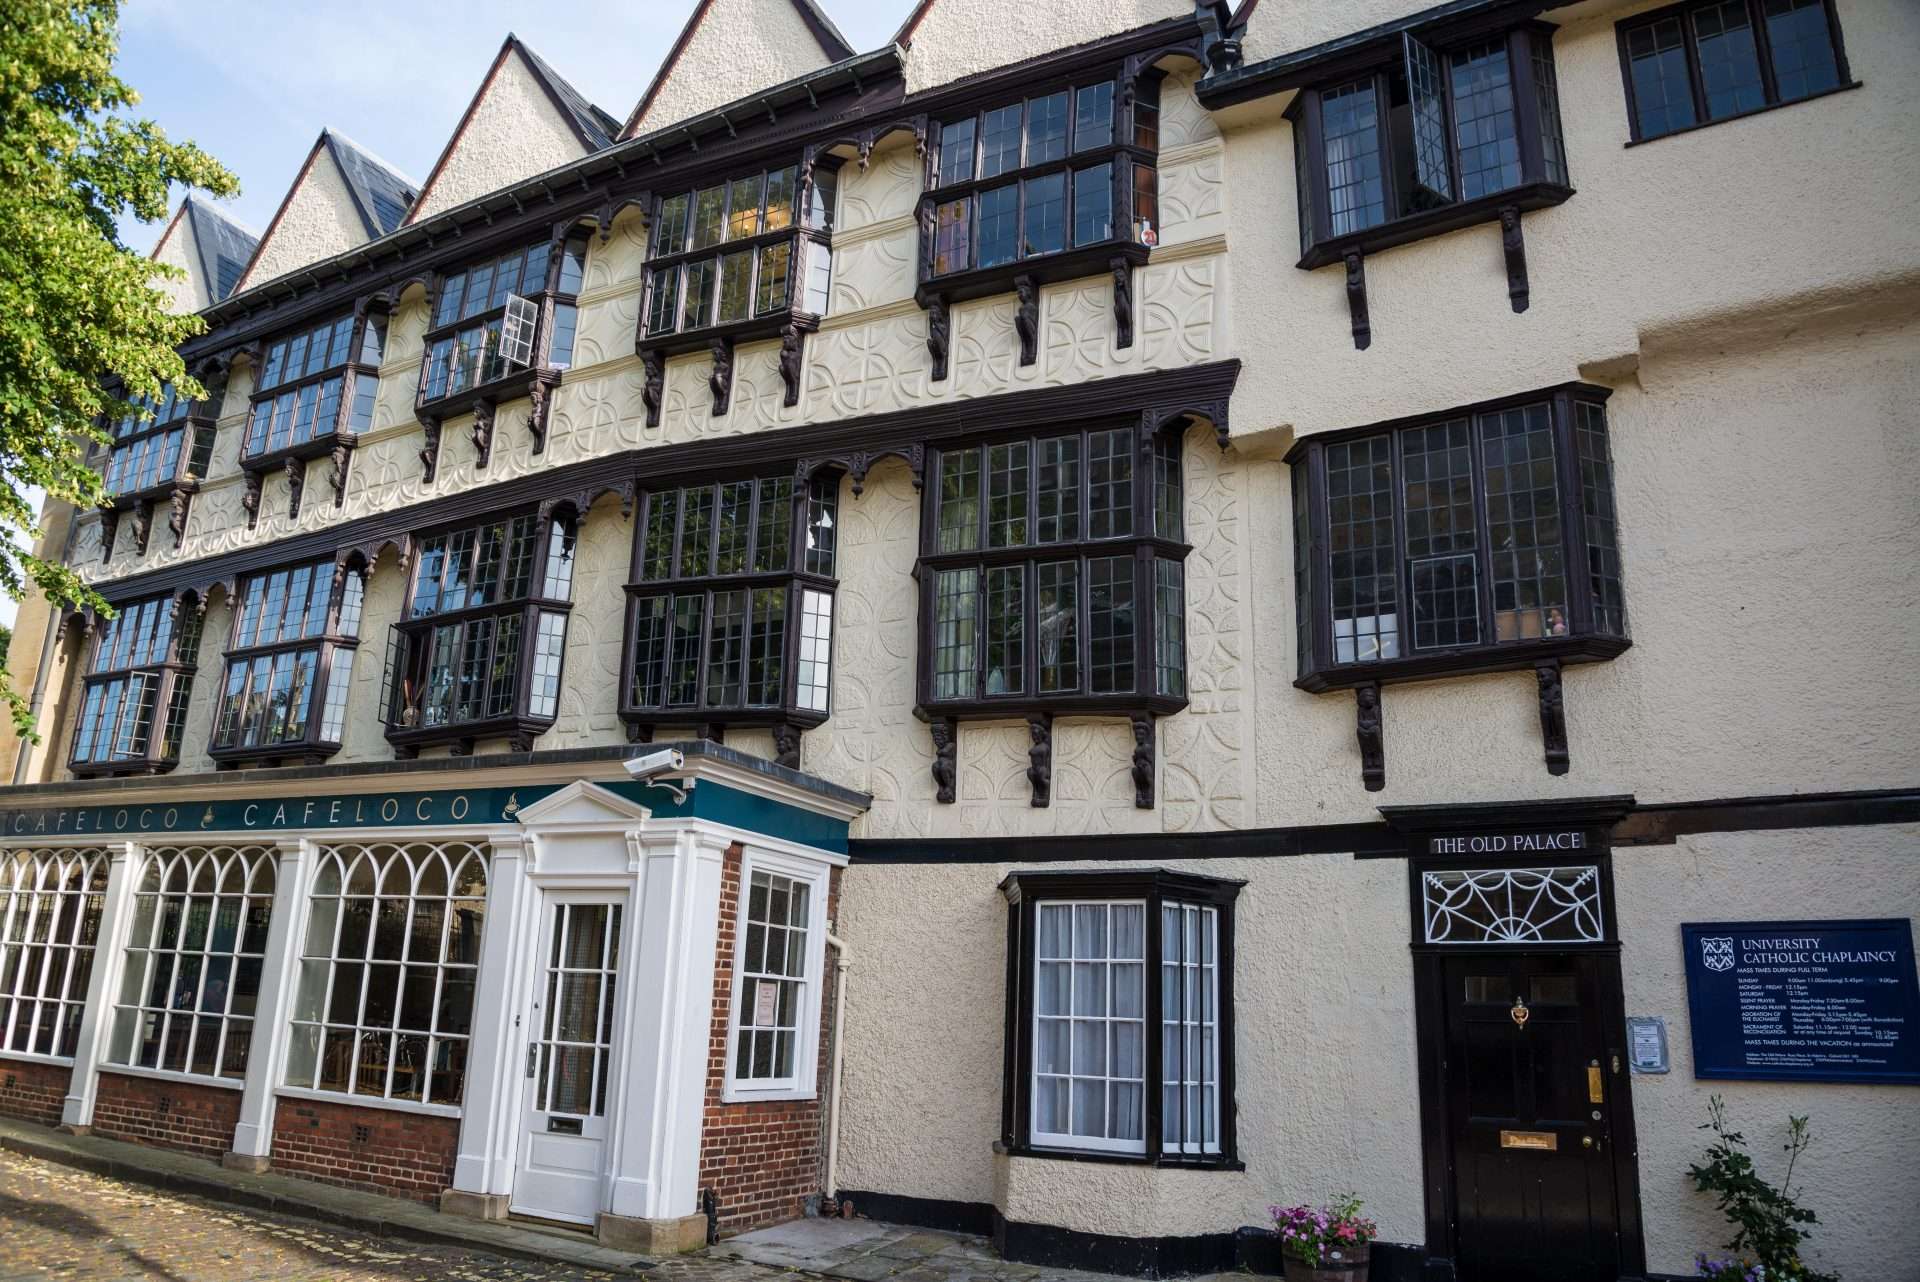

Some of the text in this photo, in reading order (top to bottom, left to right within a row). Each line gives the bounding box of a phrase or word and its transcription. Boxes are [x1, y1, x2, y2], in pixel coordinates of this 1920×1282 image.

[1433, 832, 1580, 854] THE OLD PALACE
[1742, 938, 1821, 950] UNIVERSITY
[1743, 951, 1897, 964] CATHOLIC CHAPLAINCY
